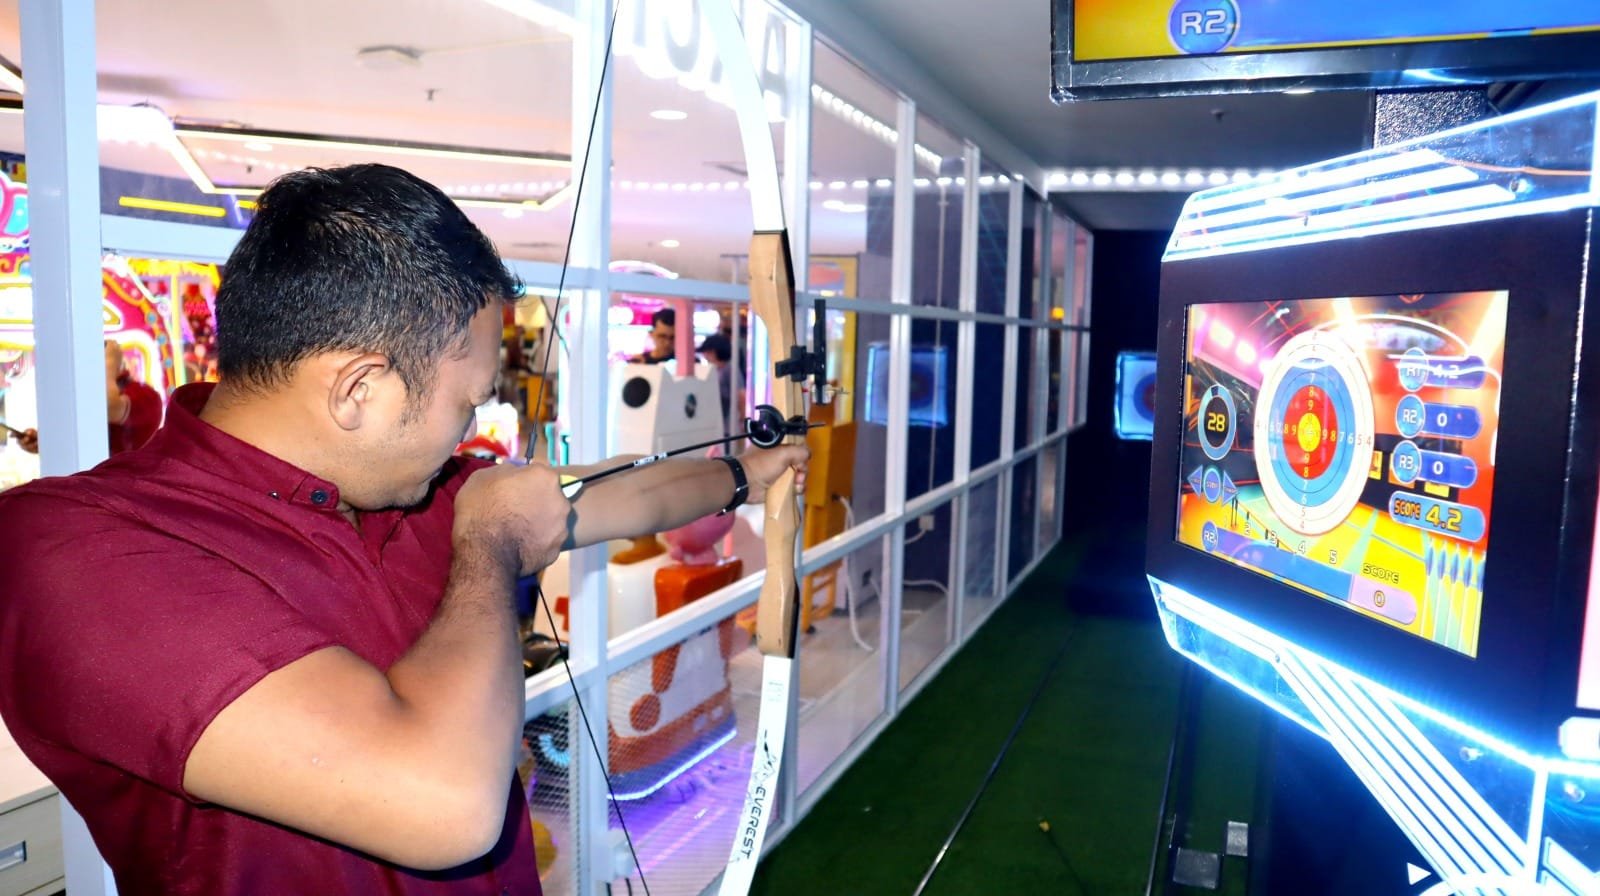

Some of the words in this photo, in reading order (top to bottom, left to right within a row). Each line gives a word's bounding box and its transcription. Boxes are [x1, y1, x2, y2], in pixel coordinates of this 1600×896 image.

[1181, 10, 1226, 35] R2
[1309, 386, 1314, 398] 8
[1308, 400, 1313, 411] 9
[1207, 412, 1226, 432] 28
[1403, 409, 1418, 424] R2
[1436, 412, 1448, 427] 0
[1284, 423, 1289, 434] 8
[1292, 424, 1297, 435] 9
[1322, 429, 1328, 440] 9
[1330, 430, 1336, 442] 8
[1339, 431, 1345, 443] 7
[1347, 432, 1354, 444] 6
[1357, 434, 1362, 445] 5
[1366, 436, 1372, 447] 4
[1303, 467, 1309, 478] 8
[1399, 454, 1414, 470] R3
[1432, 460, 1444, 475] 0
[1425, 504, 1463, 533] 4.2
[1204, 530, 1215, 543] R2
[1298, 540, 1306, 554] 4
[1329, 549, 1337, 565] 5
[1373, 590, 1385, 608] 0
[741, 785, 766, 859] EVEREST
